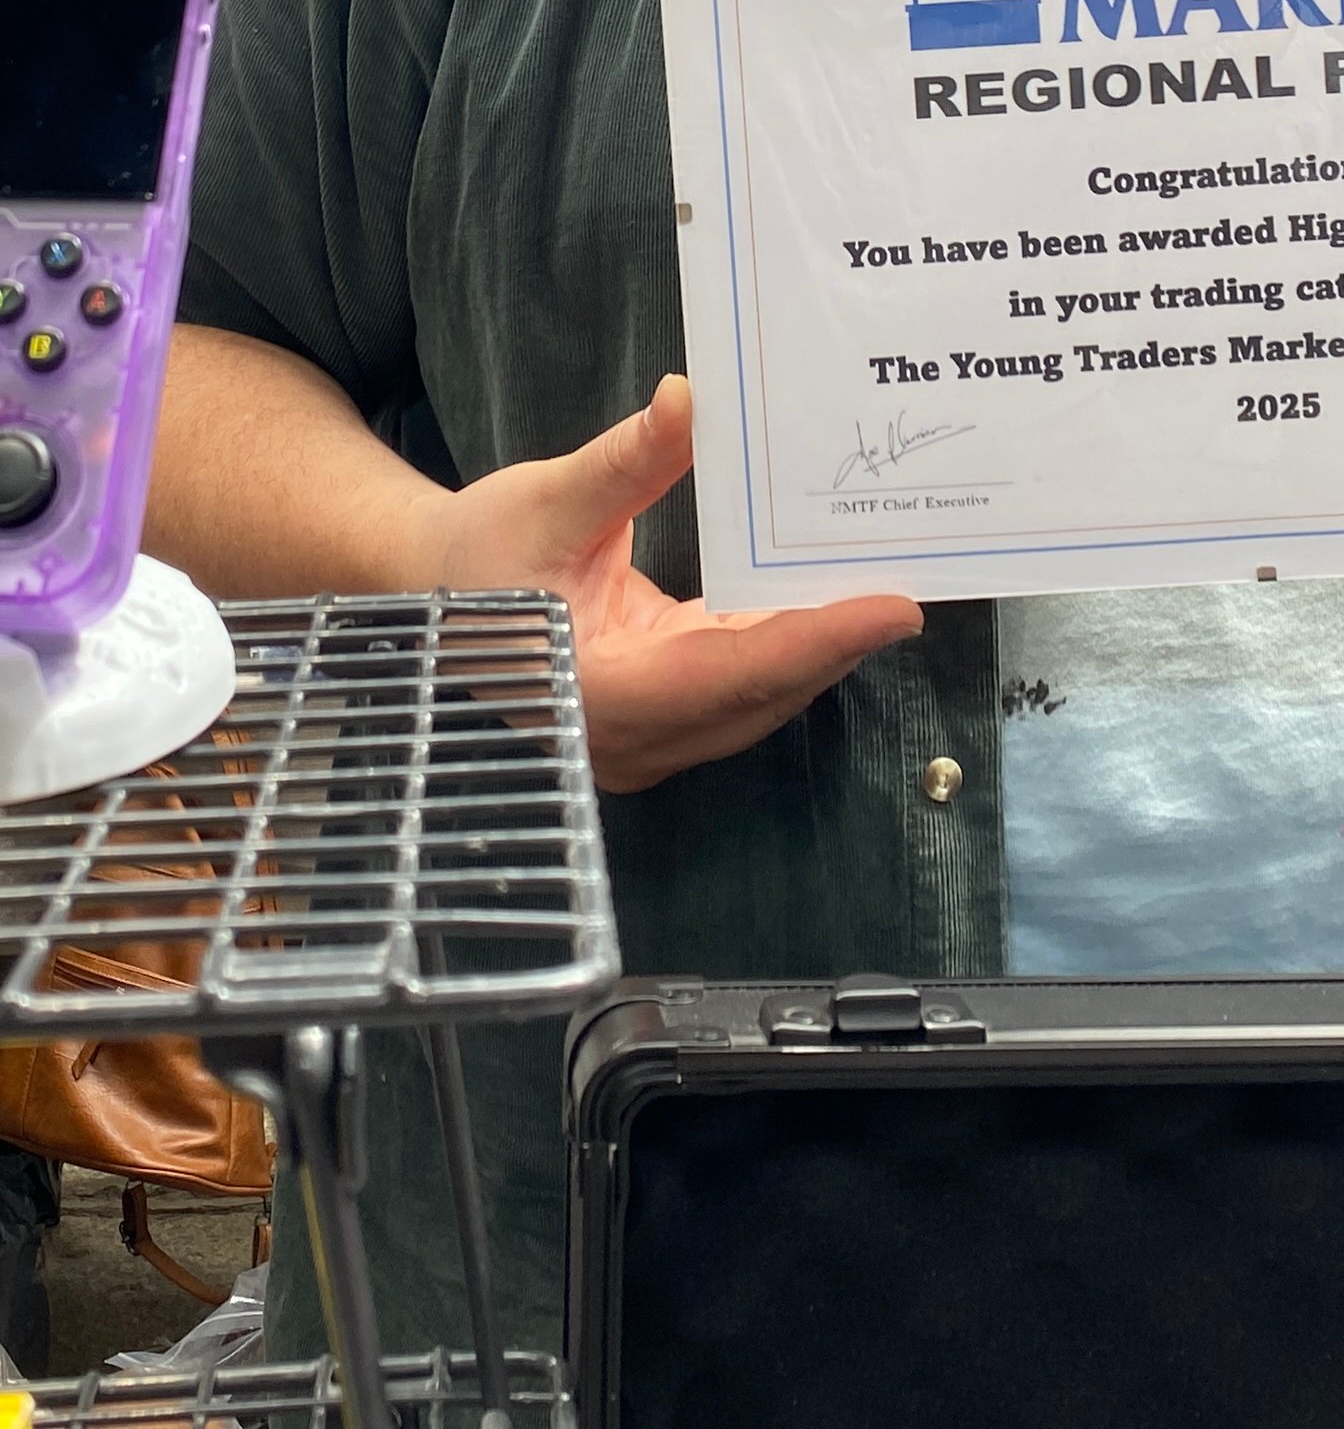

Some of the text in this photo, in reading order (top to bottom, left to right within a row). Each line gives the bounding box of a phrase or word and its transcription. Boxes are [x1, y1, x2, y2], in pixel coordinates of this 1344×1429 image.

[914, 55, 1296, 120] REGIONAL
[47, 241, 71, 265] X
[843, 240, 912, 268] You
[922, 236, 1008, 264] have
[1018, 230, 1107, 258] been
[1119, 216, 1278, 252] awarded
[87, 288, 106, 313] A
[1009, 290, 1046, 317] in
[1055, 290, 1141, 322] your
[1151, 278, 1285, 310] trading
[28, 334, 52, 360] B
[869, 355, 940, 384] The
[950, 351, 1064, 382] Young
[1073, 340, 1217, 372] Traders
[1237, 391, 1321, 422] 2025
[830, 493, 990, 515] NMTF Chief Executive
